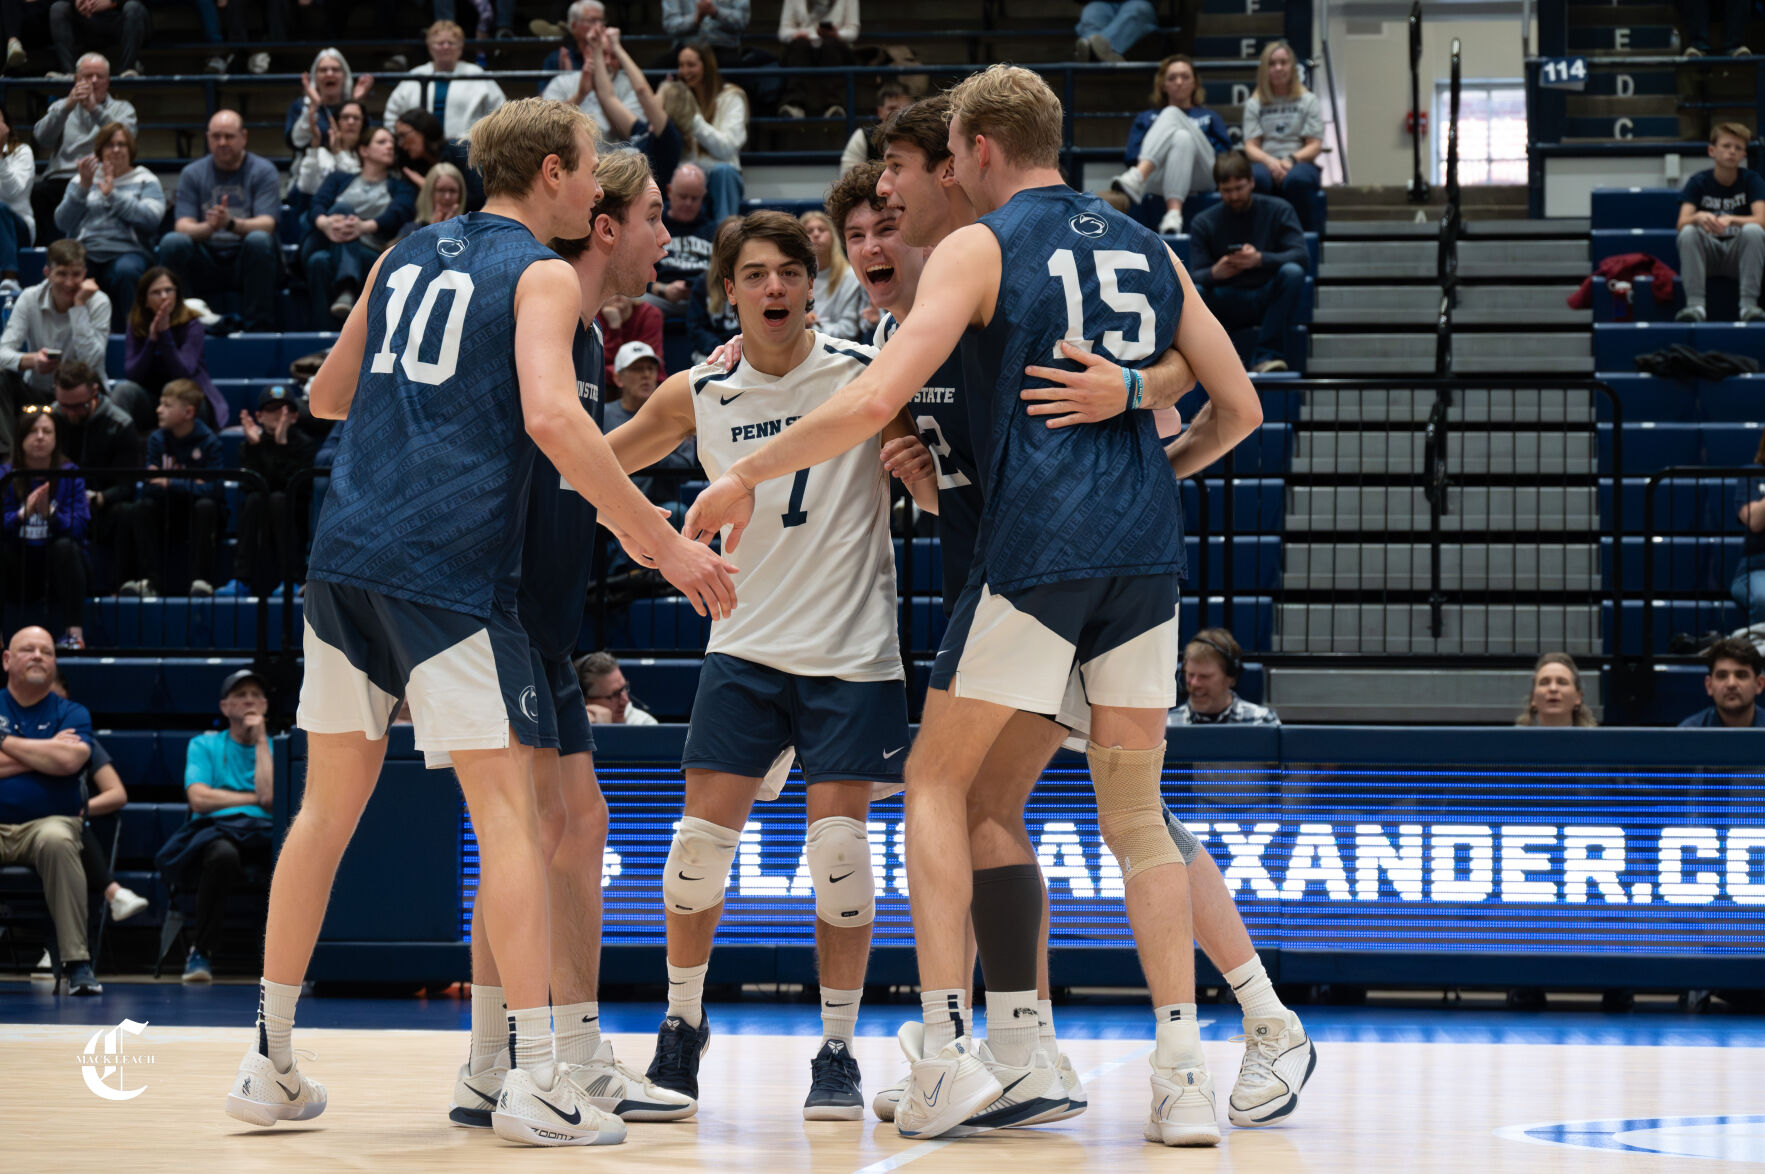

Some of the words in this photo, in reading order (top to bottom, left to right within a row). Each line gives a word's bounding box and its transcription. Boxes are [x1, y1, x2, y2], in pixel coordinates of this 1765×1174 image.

[1543, 58, 1587, 82] 114
[1231, 84, 1251, 107] D
[1616, 74, 1635, 98] D
[1613, 117, 1634, 141] C
[1047, 248, 1156, 361] 15
[371, 263, 475, 386] 10
[731, 418, 782, 443] PENN
